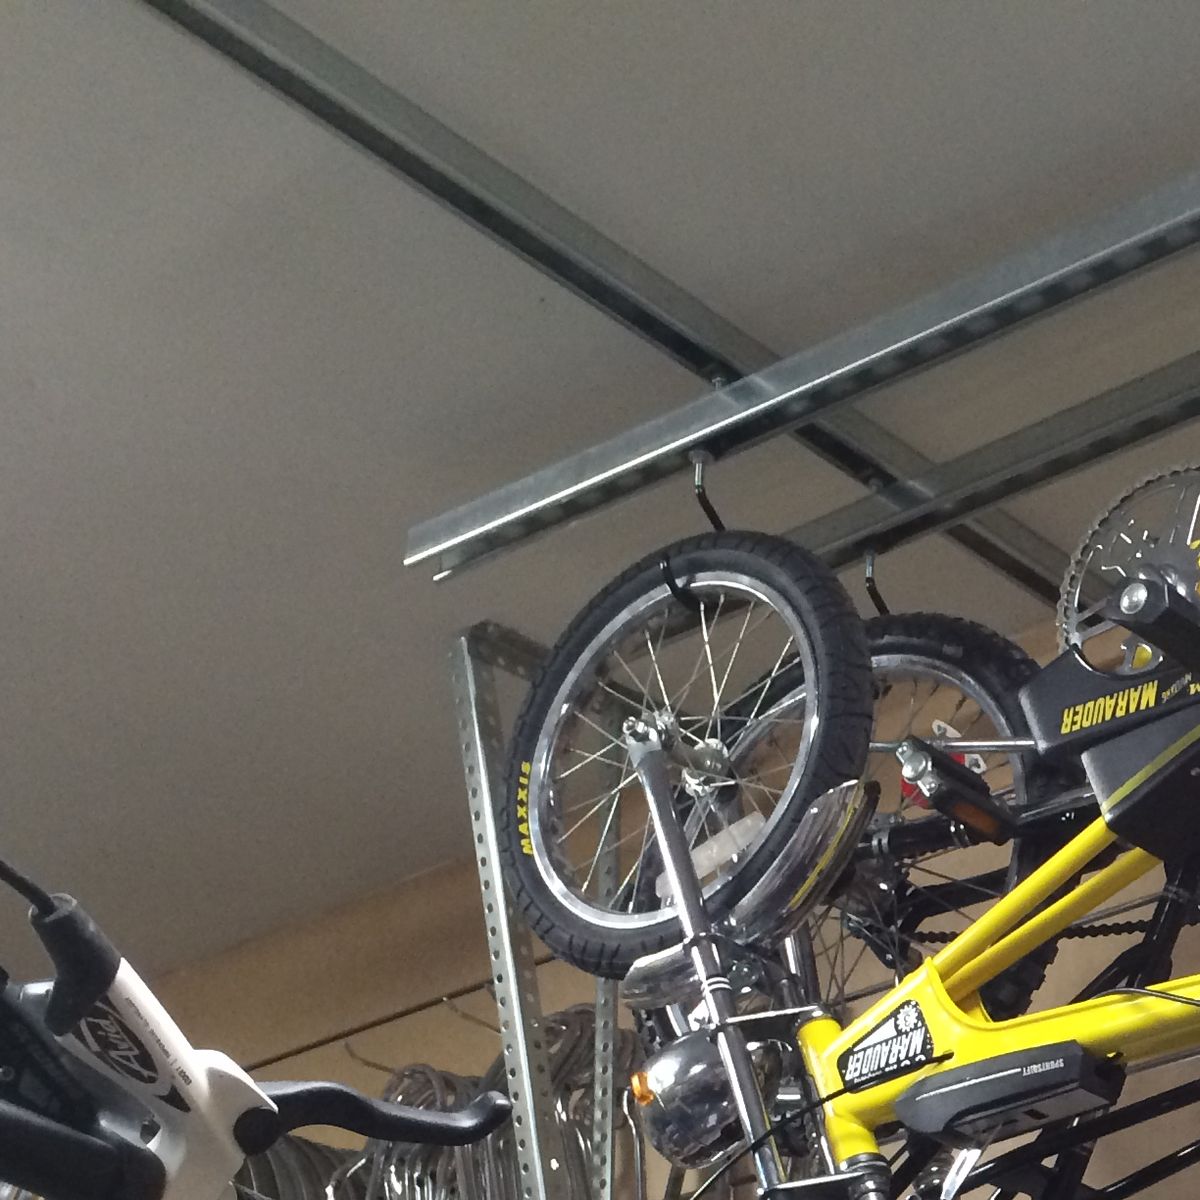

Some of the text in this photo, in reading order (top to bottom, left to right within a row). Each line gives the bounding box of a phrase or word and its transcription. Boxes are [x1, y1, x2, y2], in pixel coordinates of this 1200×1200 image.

[1060, 680, 1158, 735] MARAUDER
[517, 761, 534, 855] MAXXIS
[86, 1016, 158, 1078] Avid
[845, 1027, 925, 1081] MARAUDER
